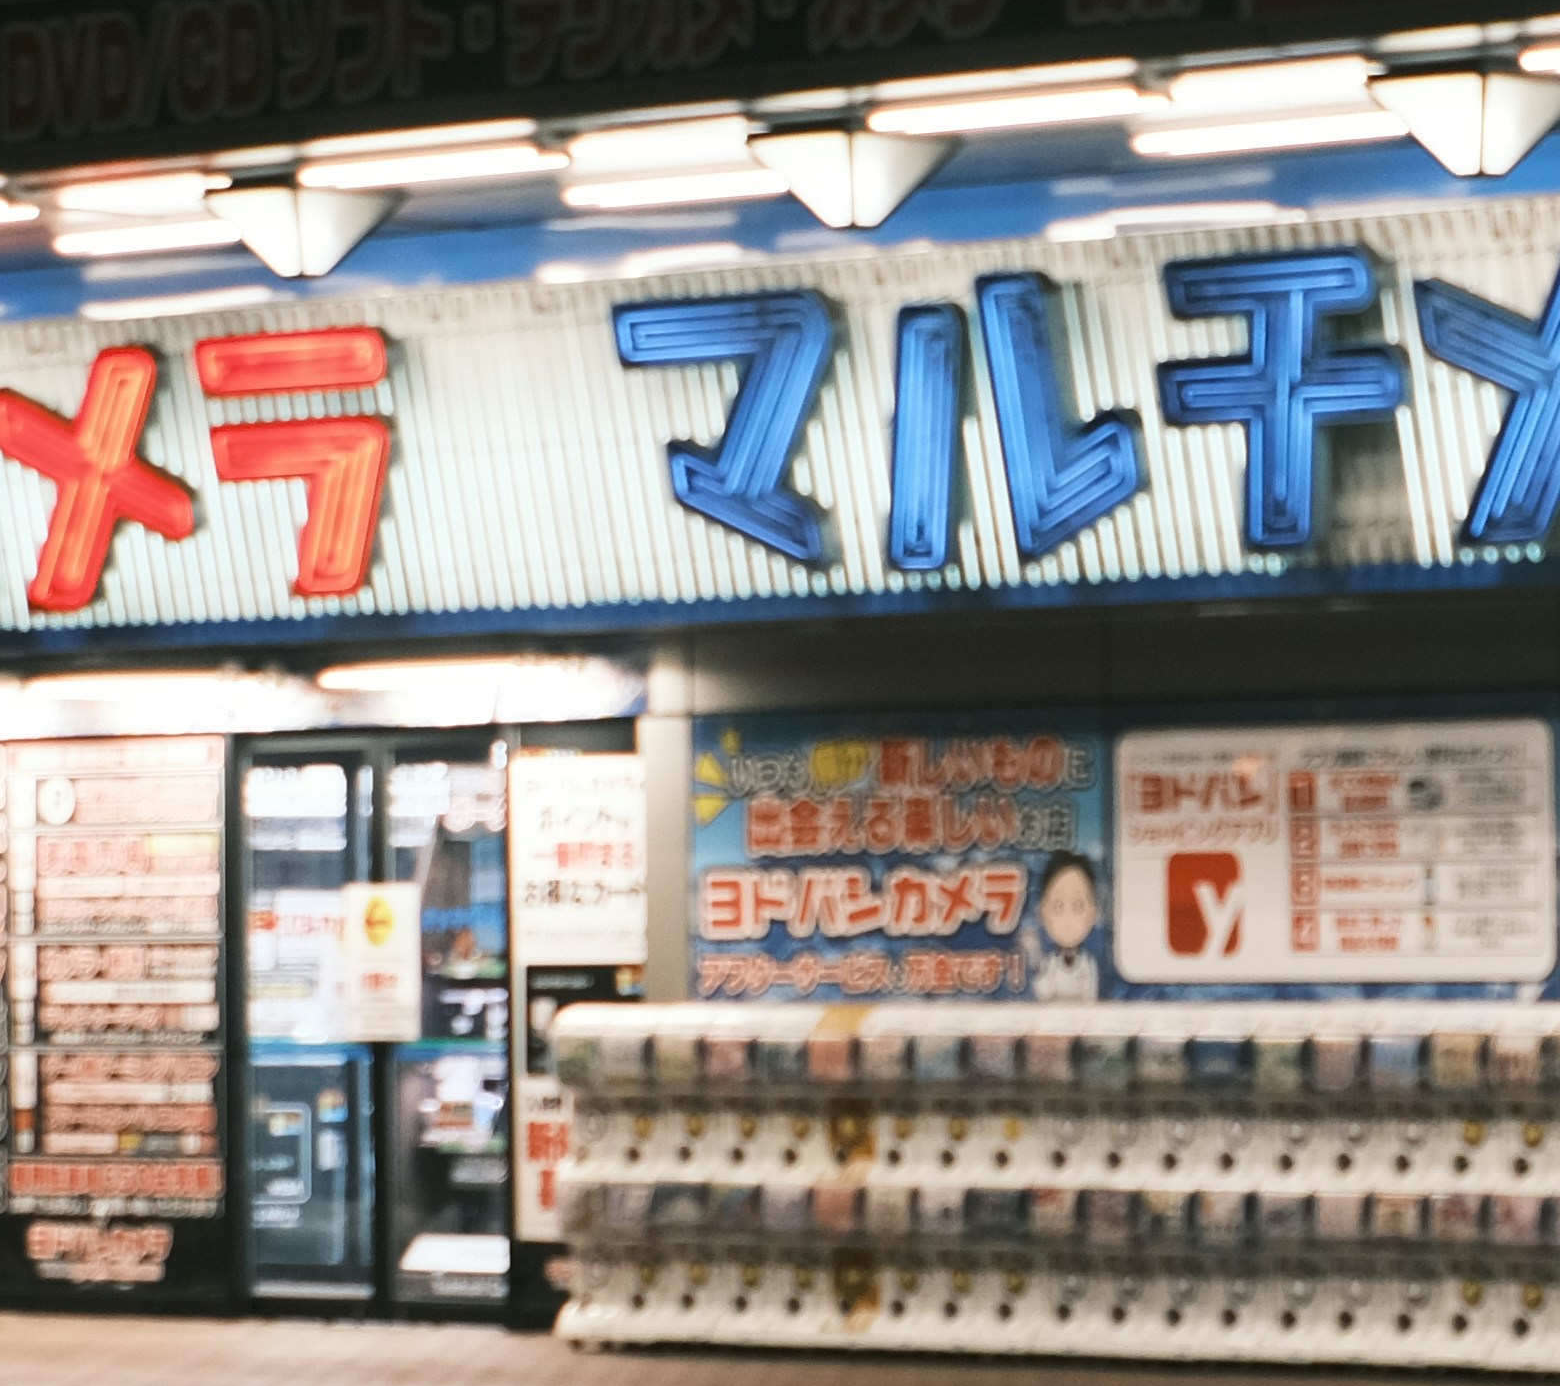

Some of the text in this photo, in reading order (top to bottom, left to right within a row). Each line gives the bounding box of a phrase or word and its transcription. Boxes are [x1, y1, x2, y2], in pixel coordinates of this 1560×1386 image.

[702, 865, 1028, 940] ヨドバシカメラ
